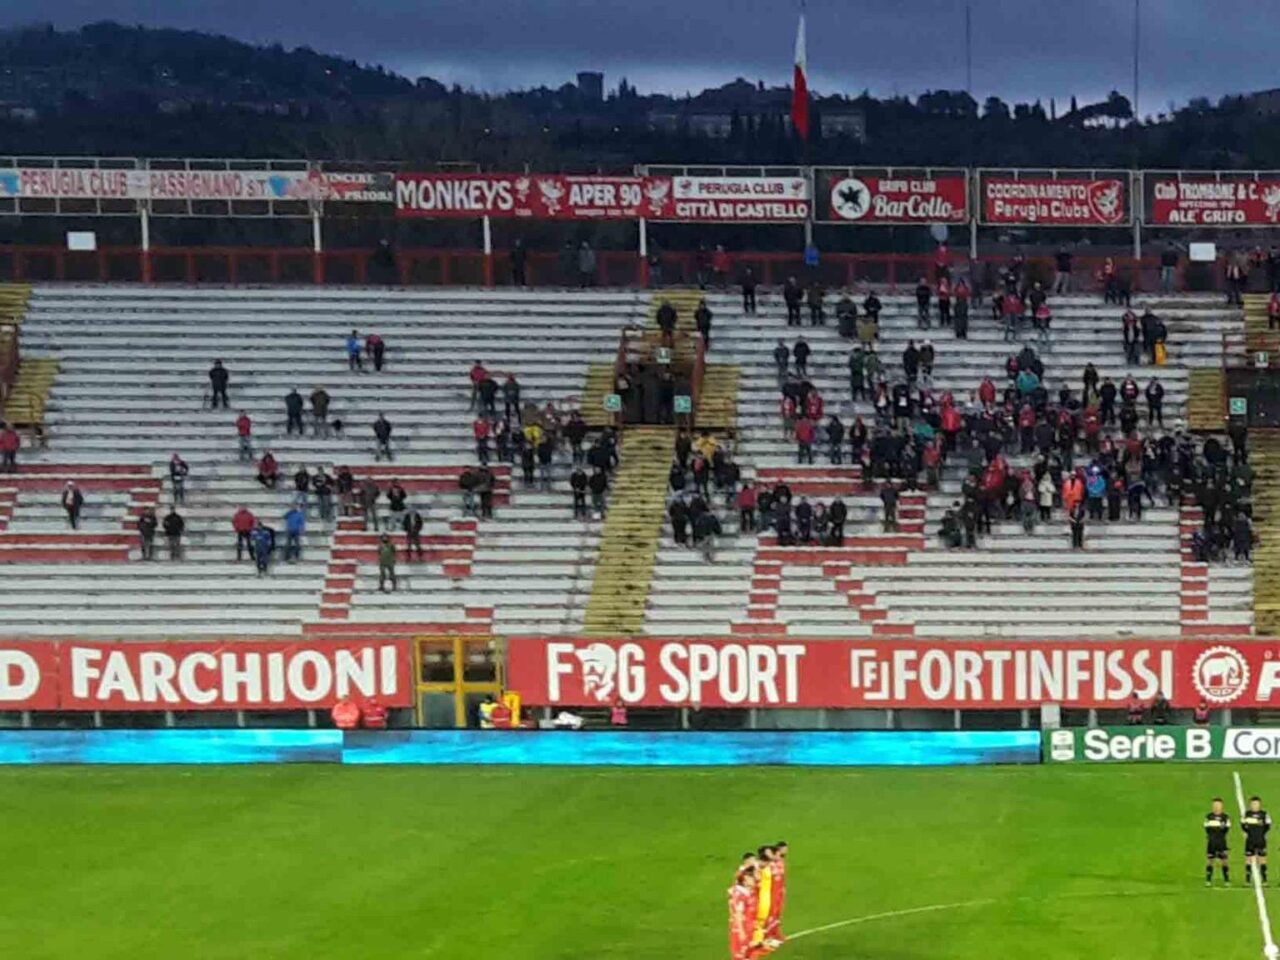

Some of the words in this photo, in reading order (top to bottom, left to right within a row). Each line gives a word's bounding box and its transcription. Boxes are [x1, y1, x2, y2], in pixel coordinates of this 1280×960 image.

[21, 171, 85, 195] PERUGIA
[90, 172, 127, 195] CLUB
[396, 179, 514, 210] MONKEYS
[569, 185, 616, 206] APER
[619, 184, 642, 206] 90
[698, 183, 751, 194] PERUGIA
[752, 183, 785, 194] CLUB
[987, 184, 1087, 199] COORDINAMENTO
[719, 203, 734, 217] DI
[736, 203, 808, 218] CASTELLO
[995, 200, 1048, 220] Perugia
[1051, 202, 1091, 217] Clubs
[71, 645, 397, 702] FARCHIONI
[659, 643, 806, 702] SPORT
[893, 650, 1173, 700] FORTINFISSI
[1084, 731, 1176, 759] Serie
[1186, 730, 1211, 758] B
